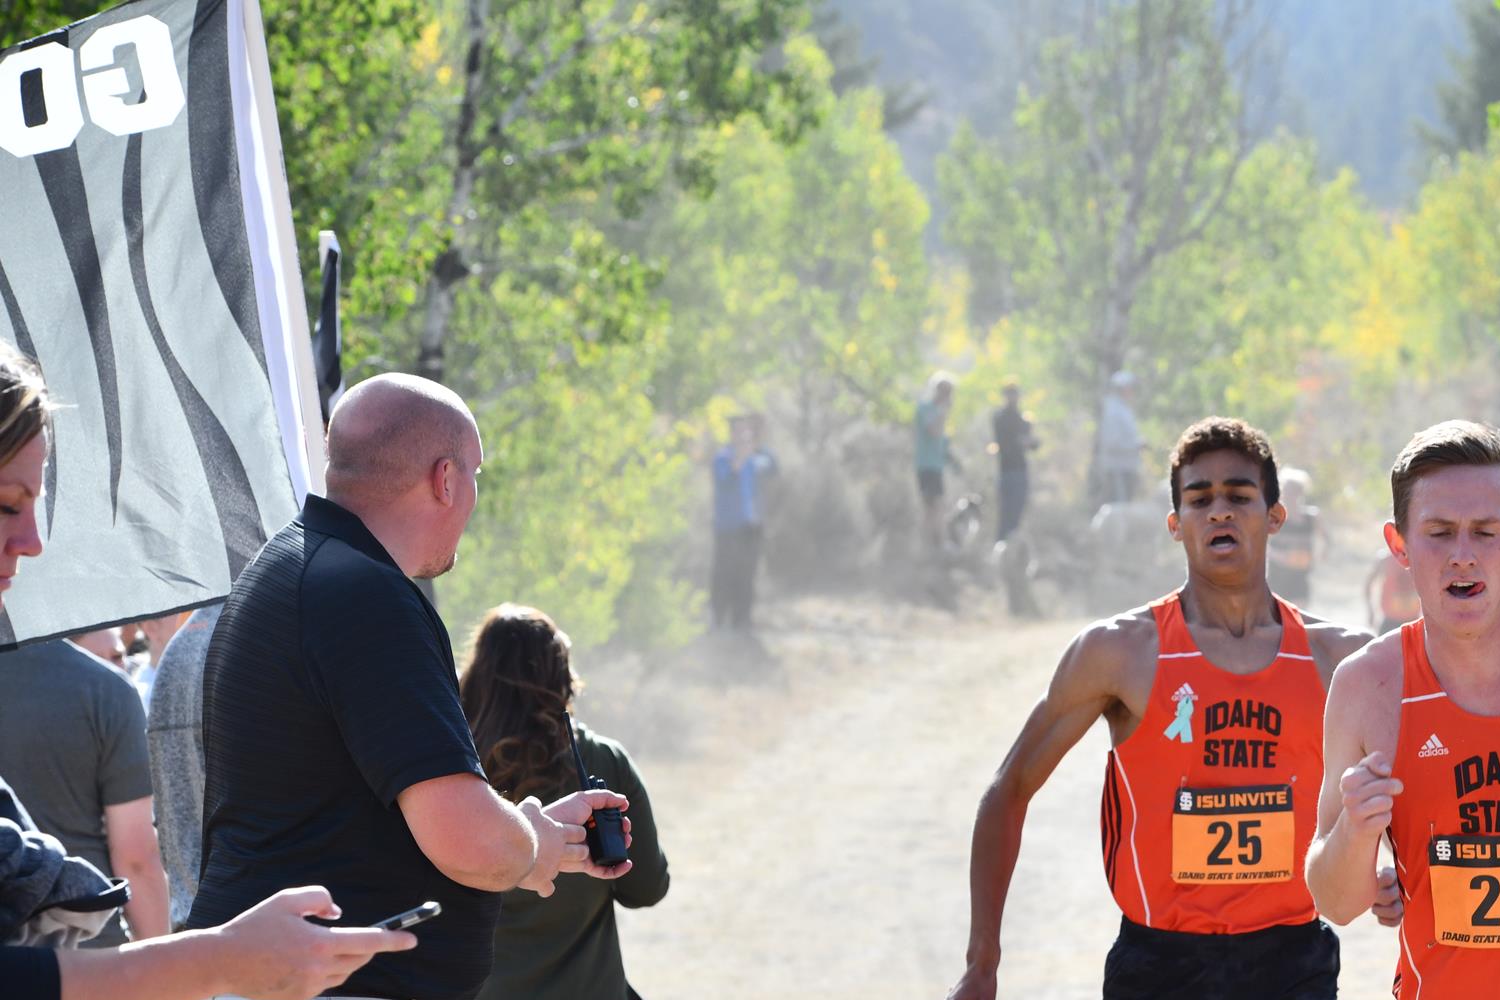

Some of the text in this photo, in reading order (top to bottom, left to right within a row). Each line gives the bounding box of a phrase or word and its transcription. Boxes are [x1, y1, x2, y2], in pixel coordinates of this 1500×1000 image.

[1205, 699, 1282, 736] IDAHO
[1204, 739, 1278, 768] STATE
[1418, 746, 1449, 758] adidas
[1196, 794, 1226, 809] ISU
[1230, 791, 1287, 807] INVITE
[1207, 820, 1262, 866] 25
[1456, 843, 1490, 860] ISU
[1177, 870, 1289, 880] IDAHO STATE UNIVERSITY
[1442, 931, 1470, 942] IDAHO
